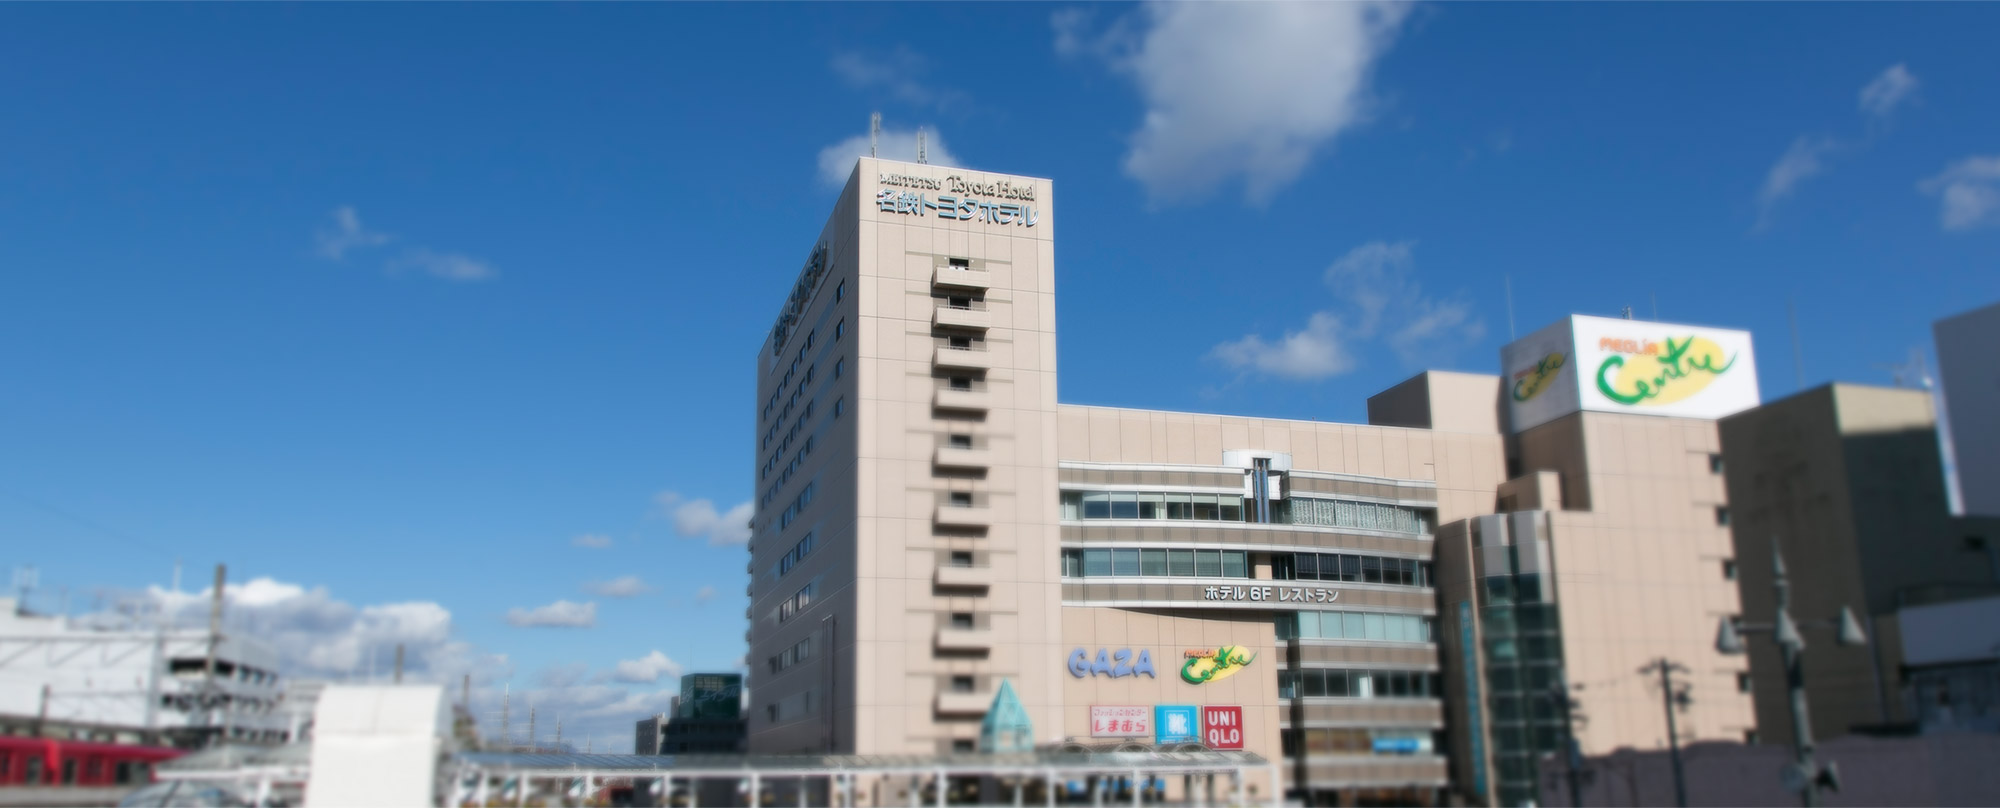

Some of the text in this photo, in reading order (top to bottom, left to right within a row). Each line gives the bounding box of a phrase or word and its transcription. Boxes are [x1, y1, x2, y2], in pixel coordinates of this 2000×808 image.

[946, 175, 995, 197] Toyota
[995, 181, 1035, 201] Hotel
[876, 188, 1039, 228] 名鉄トヨタホテル
[1596, 335, 1738, 406] Centre
[1205, 585, 1339, 603] ホテル 6F レストラン
[1068, 648, 1156, 680] GAZA
[1180, 645, 1258, 685] Centre
[1094, 719, 1147, 734] しまむら
[1208, 710, 1237, 727] UNI
[1209, 728, 1240, 747] QLO
